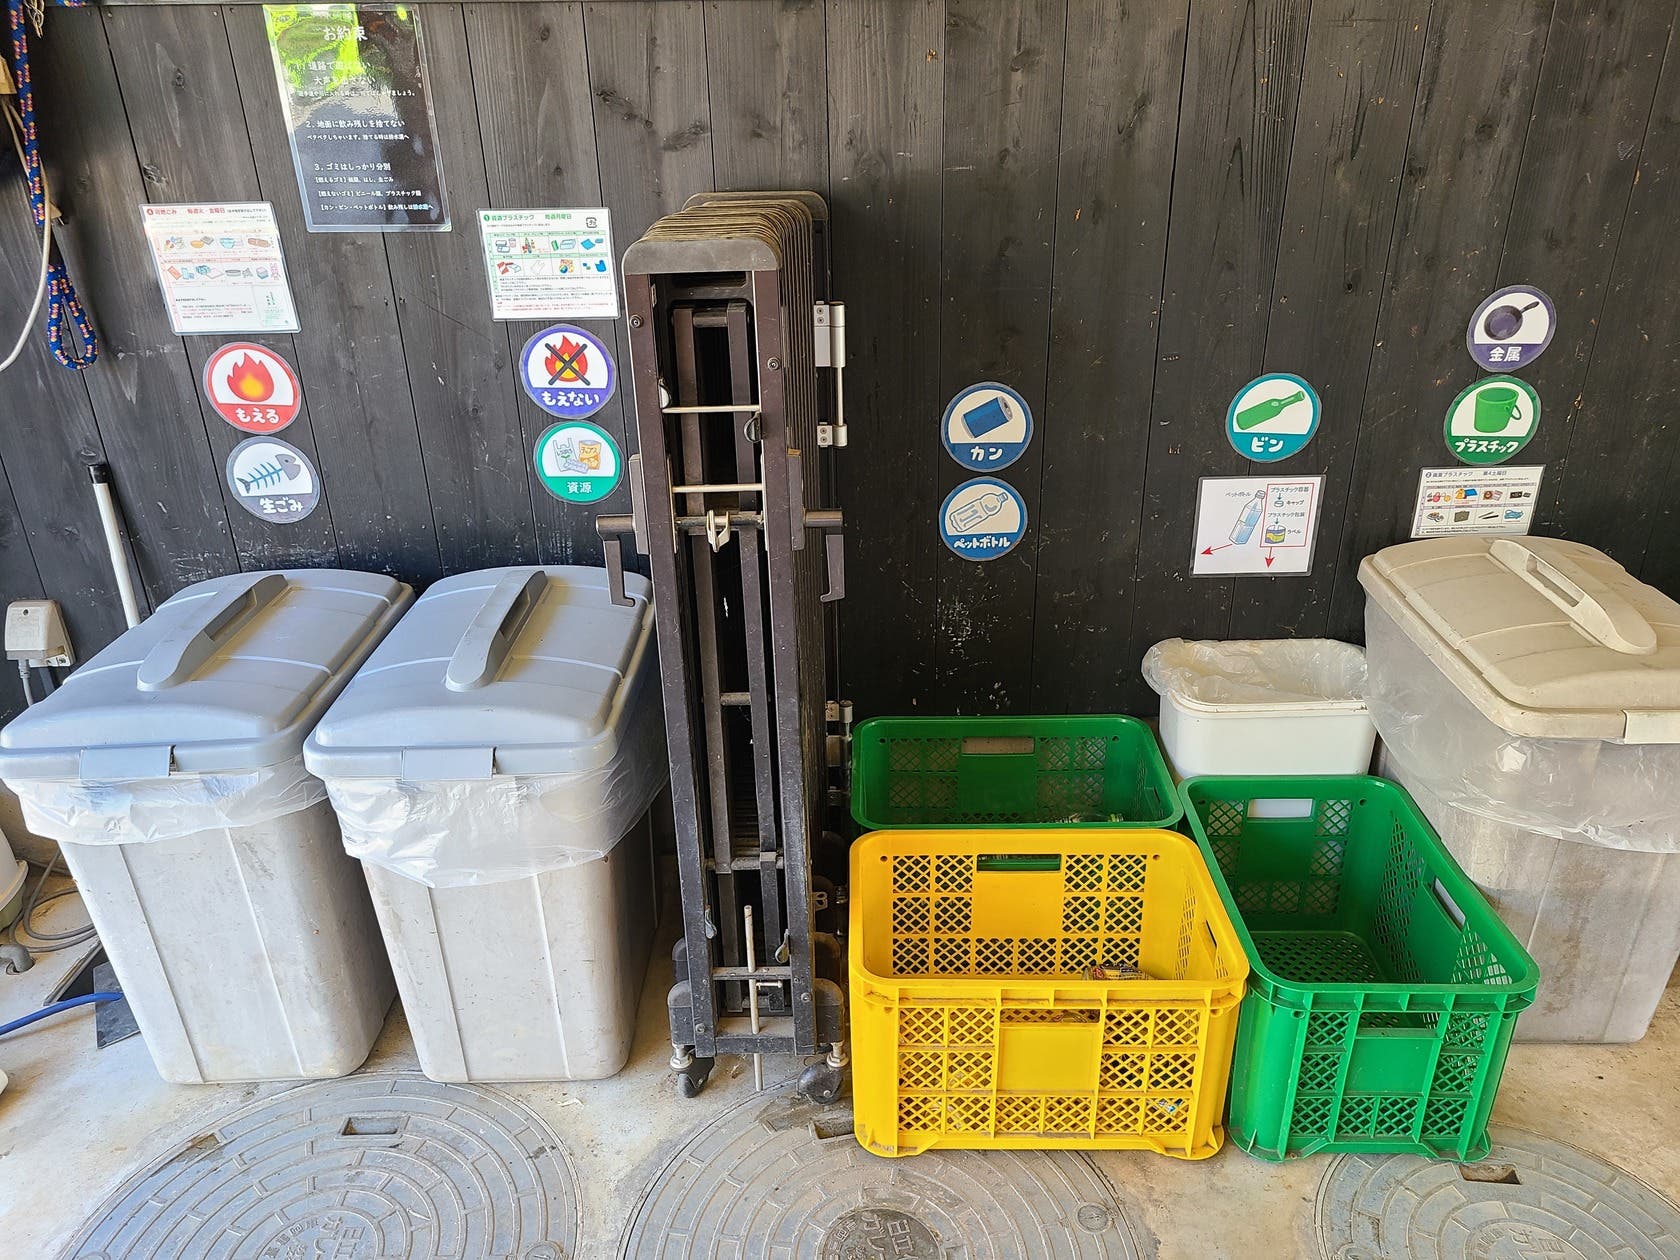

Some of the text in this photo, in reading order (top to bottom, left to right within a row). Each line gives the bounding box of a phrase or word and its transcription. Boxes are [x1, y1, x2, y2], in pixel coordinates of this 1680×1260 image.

[322, 25, 369, 42] お約束
[1488, 346, 1522, 362] 金属
[541, 391, 600, 407] もえない
[235, 407, 280, 424] もえる
[1251, 436, 1284, 453] ビン
[1455, 438, 1519, 453] プラスチック
[970, 446, 1003, 462] カン
[567, 481, 593, 494] 資源
[259, 497, 303, 514] 生ごみ
[953, 535, 1011, 549] ペットボトル
